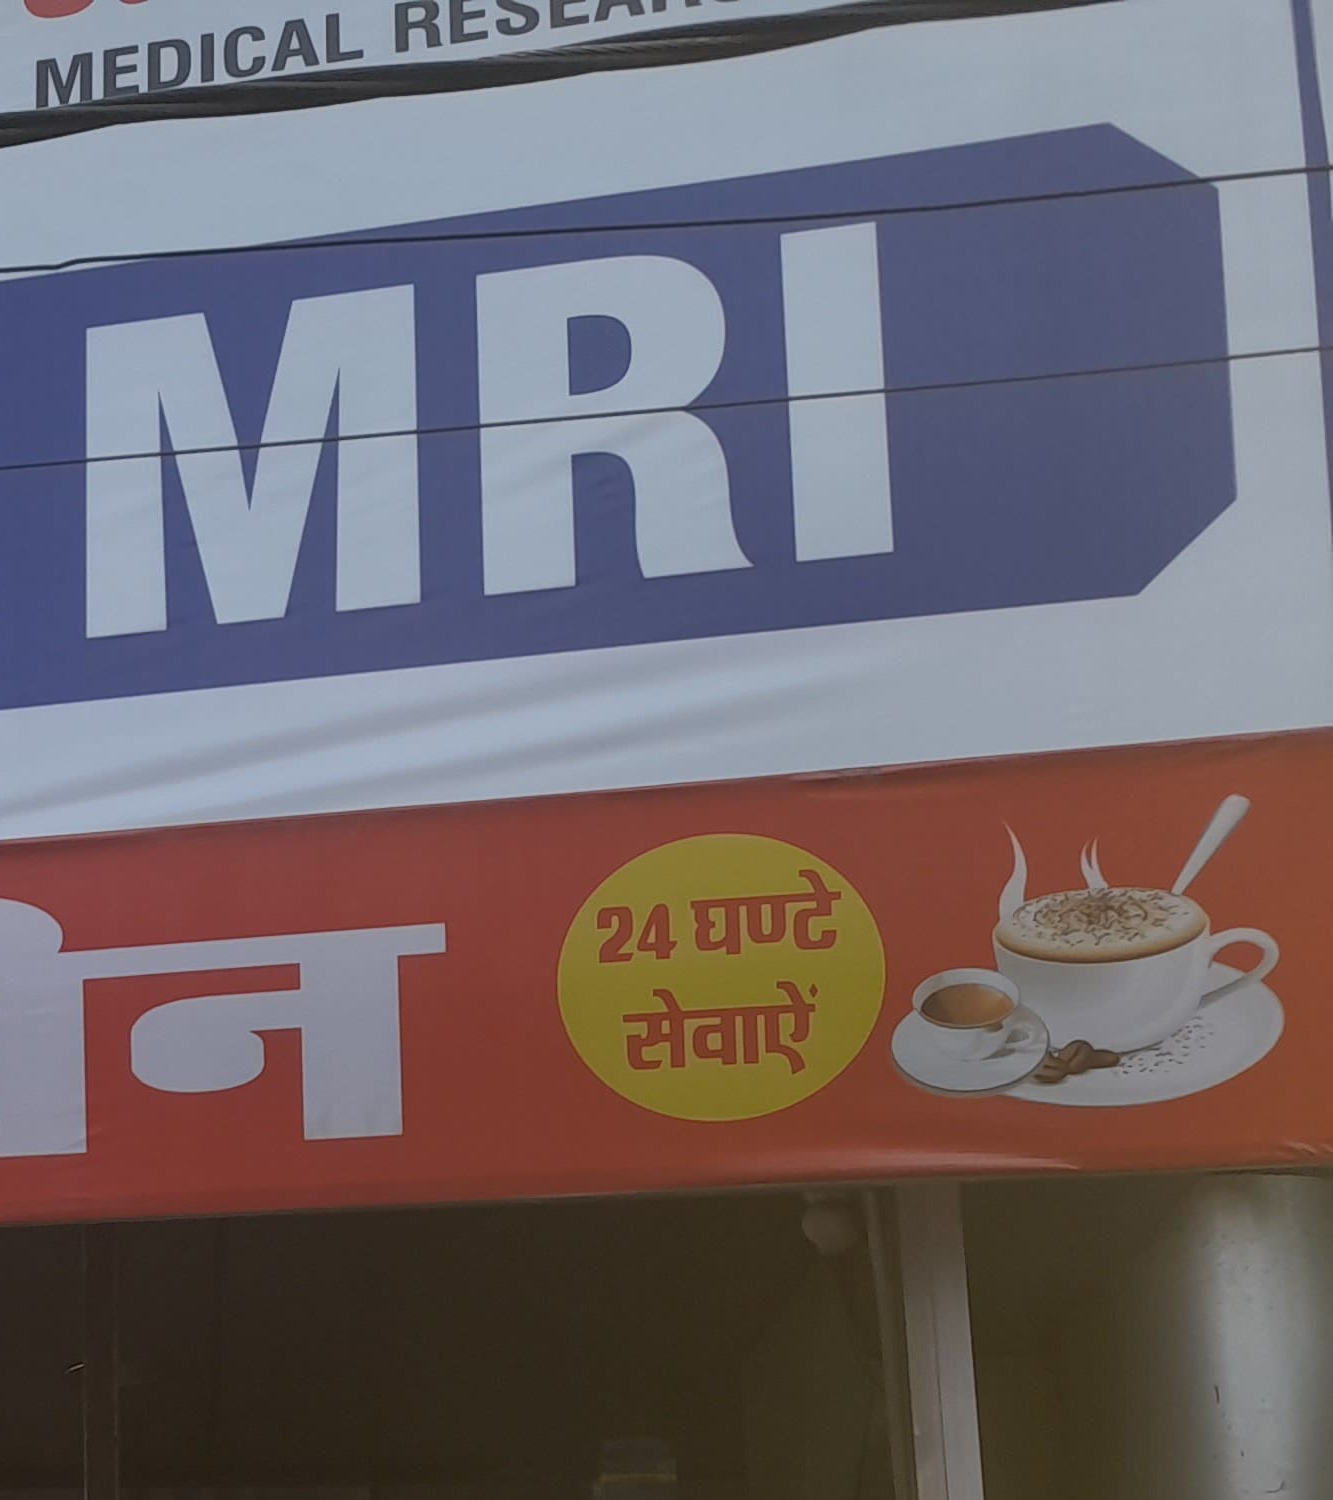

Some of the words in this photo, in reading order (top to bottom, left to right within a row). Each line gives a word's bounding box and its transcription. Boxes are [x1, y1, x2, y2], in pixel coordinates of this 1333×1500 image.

[35, 12, 364, 109] MEDICAL
[394, 0, 743, 52] RESE
[84, 221, 895, 640] MRI
[596, 901, 676, 964] 24
[688, 868, 843, 956] घण्टे
